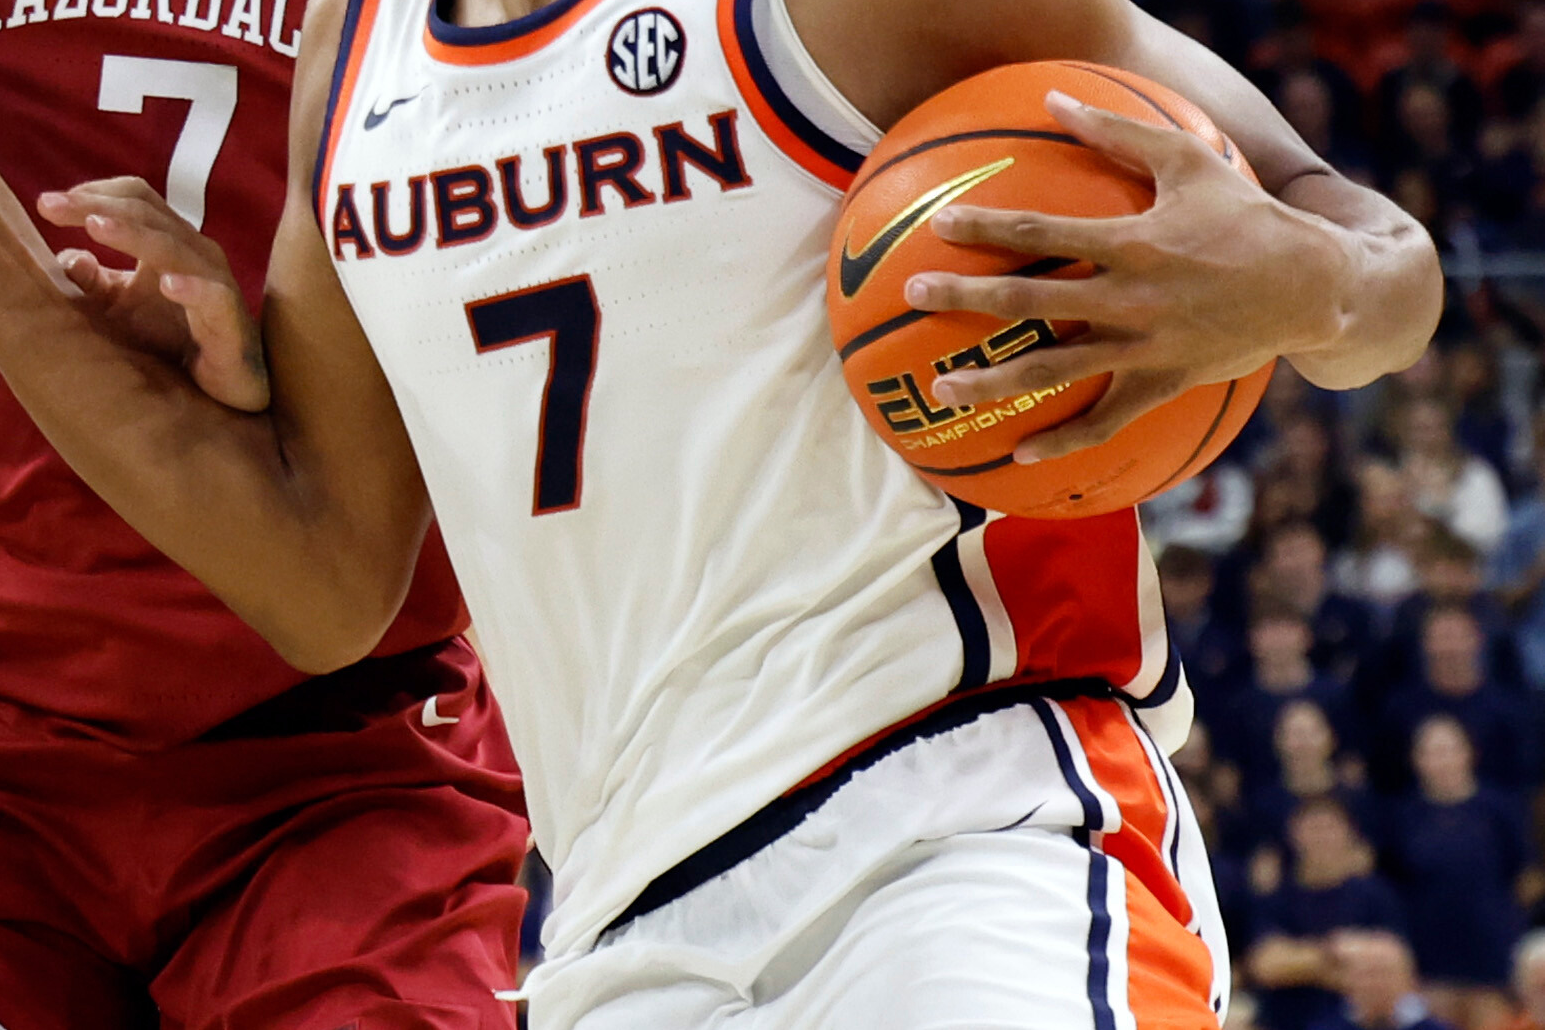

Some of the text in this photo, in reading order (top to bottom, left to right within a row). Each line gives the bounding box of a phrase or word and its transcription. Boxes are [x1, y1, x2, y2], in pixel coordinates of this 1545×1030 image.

[611, 12, 680, 90] SEC
[97, 54, 239, 232] 7
[332, 107, 753, 260] AUBURN
[464, 273, 601, 518] 7
[901, 381, 1071, 450] CHAMPIONSH
